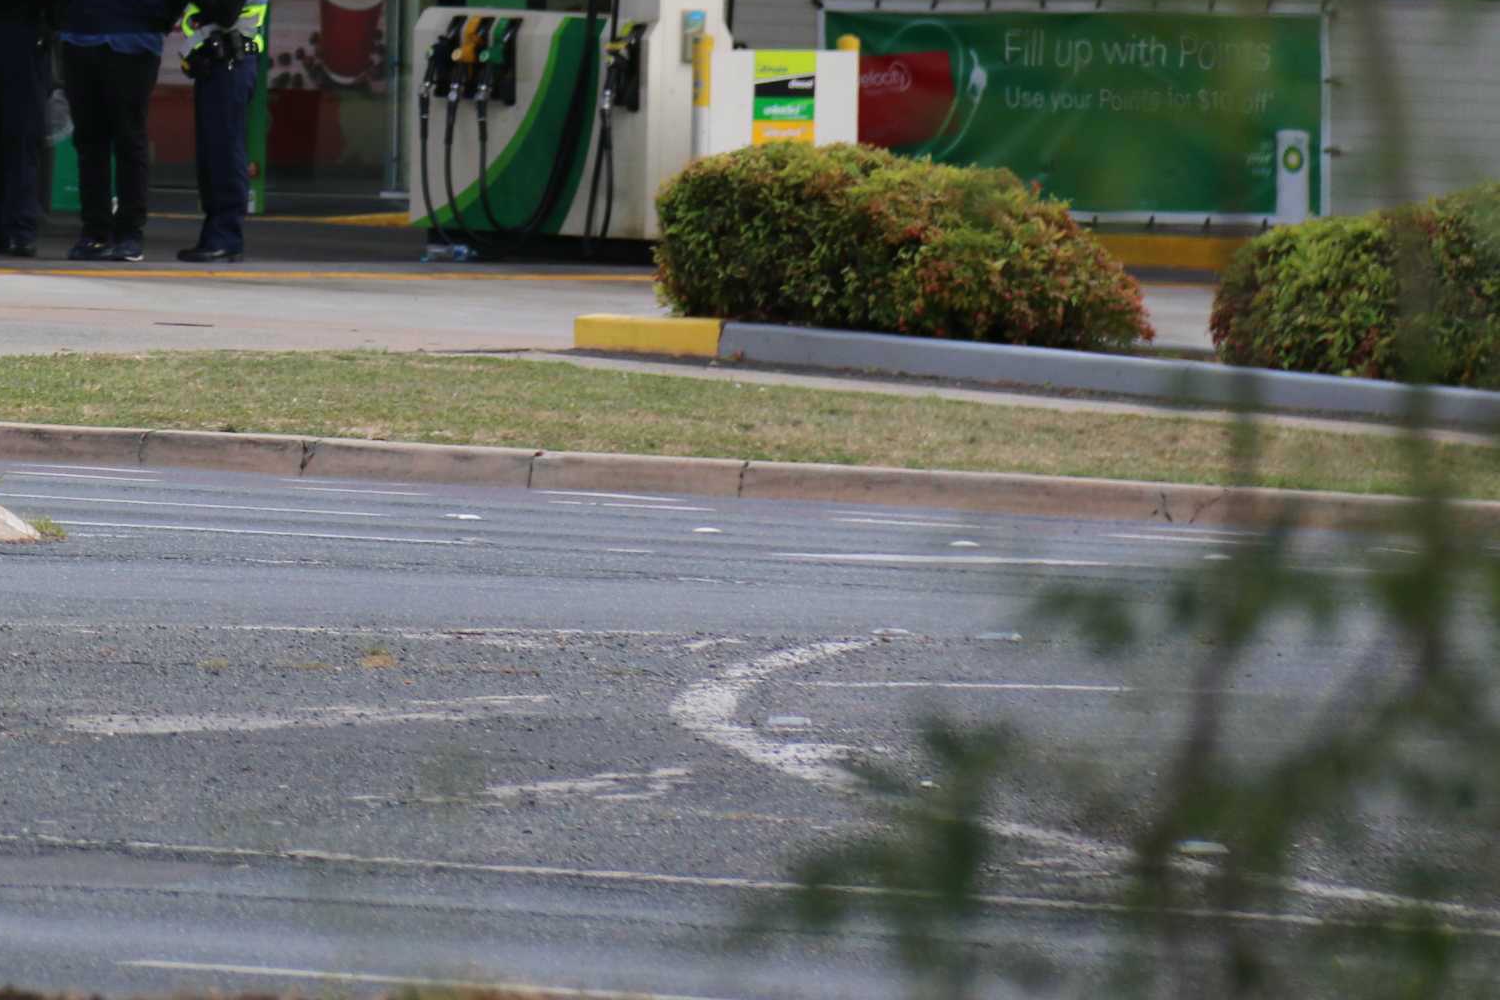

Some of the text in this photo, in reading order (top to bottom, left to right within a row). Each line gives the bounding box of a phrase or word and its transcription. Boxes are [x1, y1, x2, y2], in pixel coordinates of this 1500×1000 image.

[1004, 29, 1044, 66] Fill
[1054, 40, 1093, 77] up
[1101, 33, 1167, 67] with
